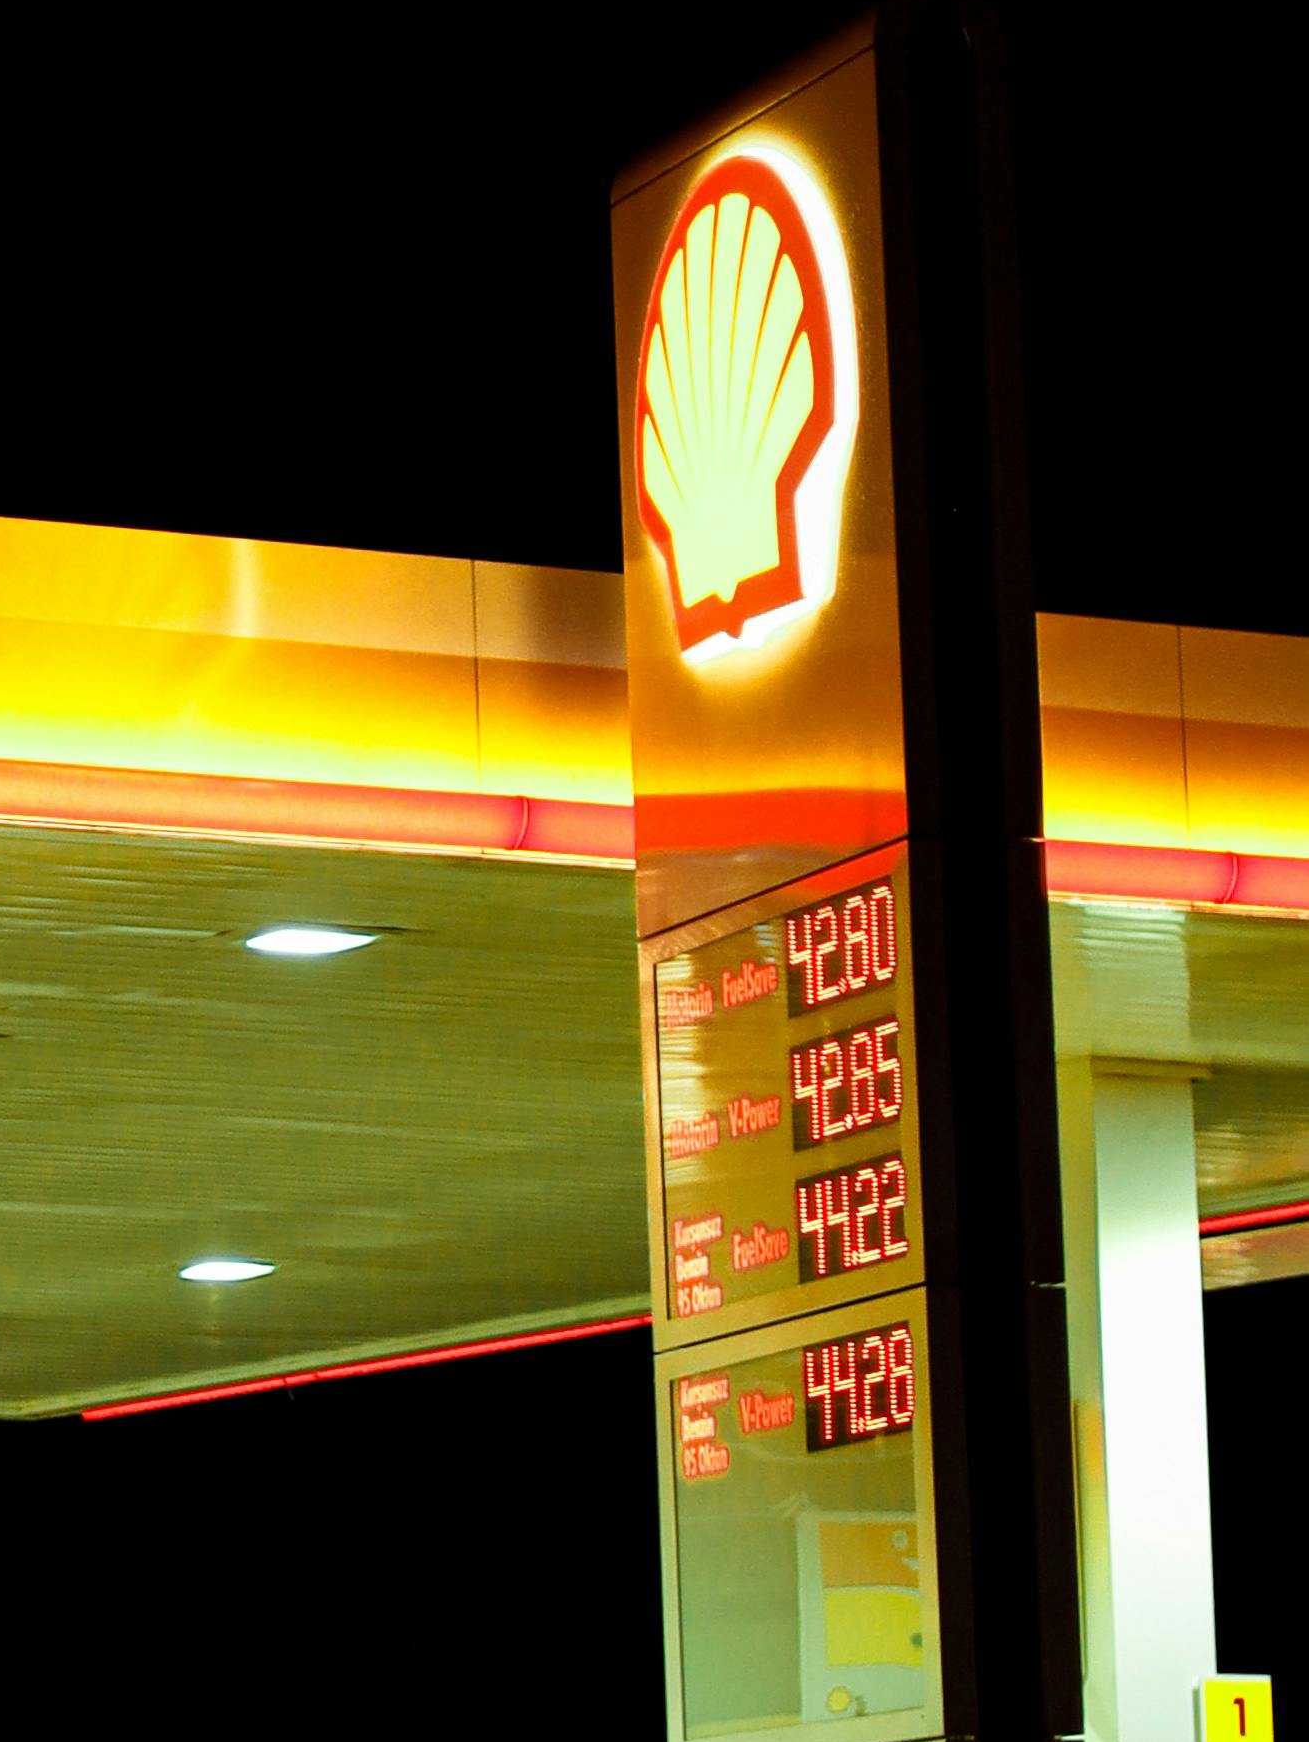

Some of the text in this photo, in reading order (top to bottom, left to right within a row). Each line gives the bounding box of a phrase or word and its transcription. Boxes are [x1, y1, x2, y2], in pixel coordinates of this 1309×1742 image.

[721, 962, 778, 1006] FuelSave
[787, 885, 896, 1005] 42.80
[671, 1020, 902, 1157] Motorin V-Power 42.85
[734, 1158, 909, 1276] FuelSave 44.22
[740, 1328, 915, 1441] V-Power 44.28
[1233, 1696, 1246, 1736] 1
